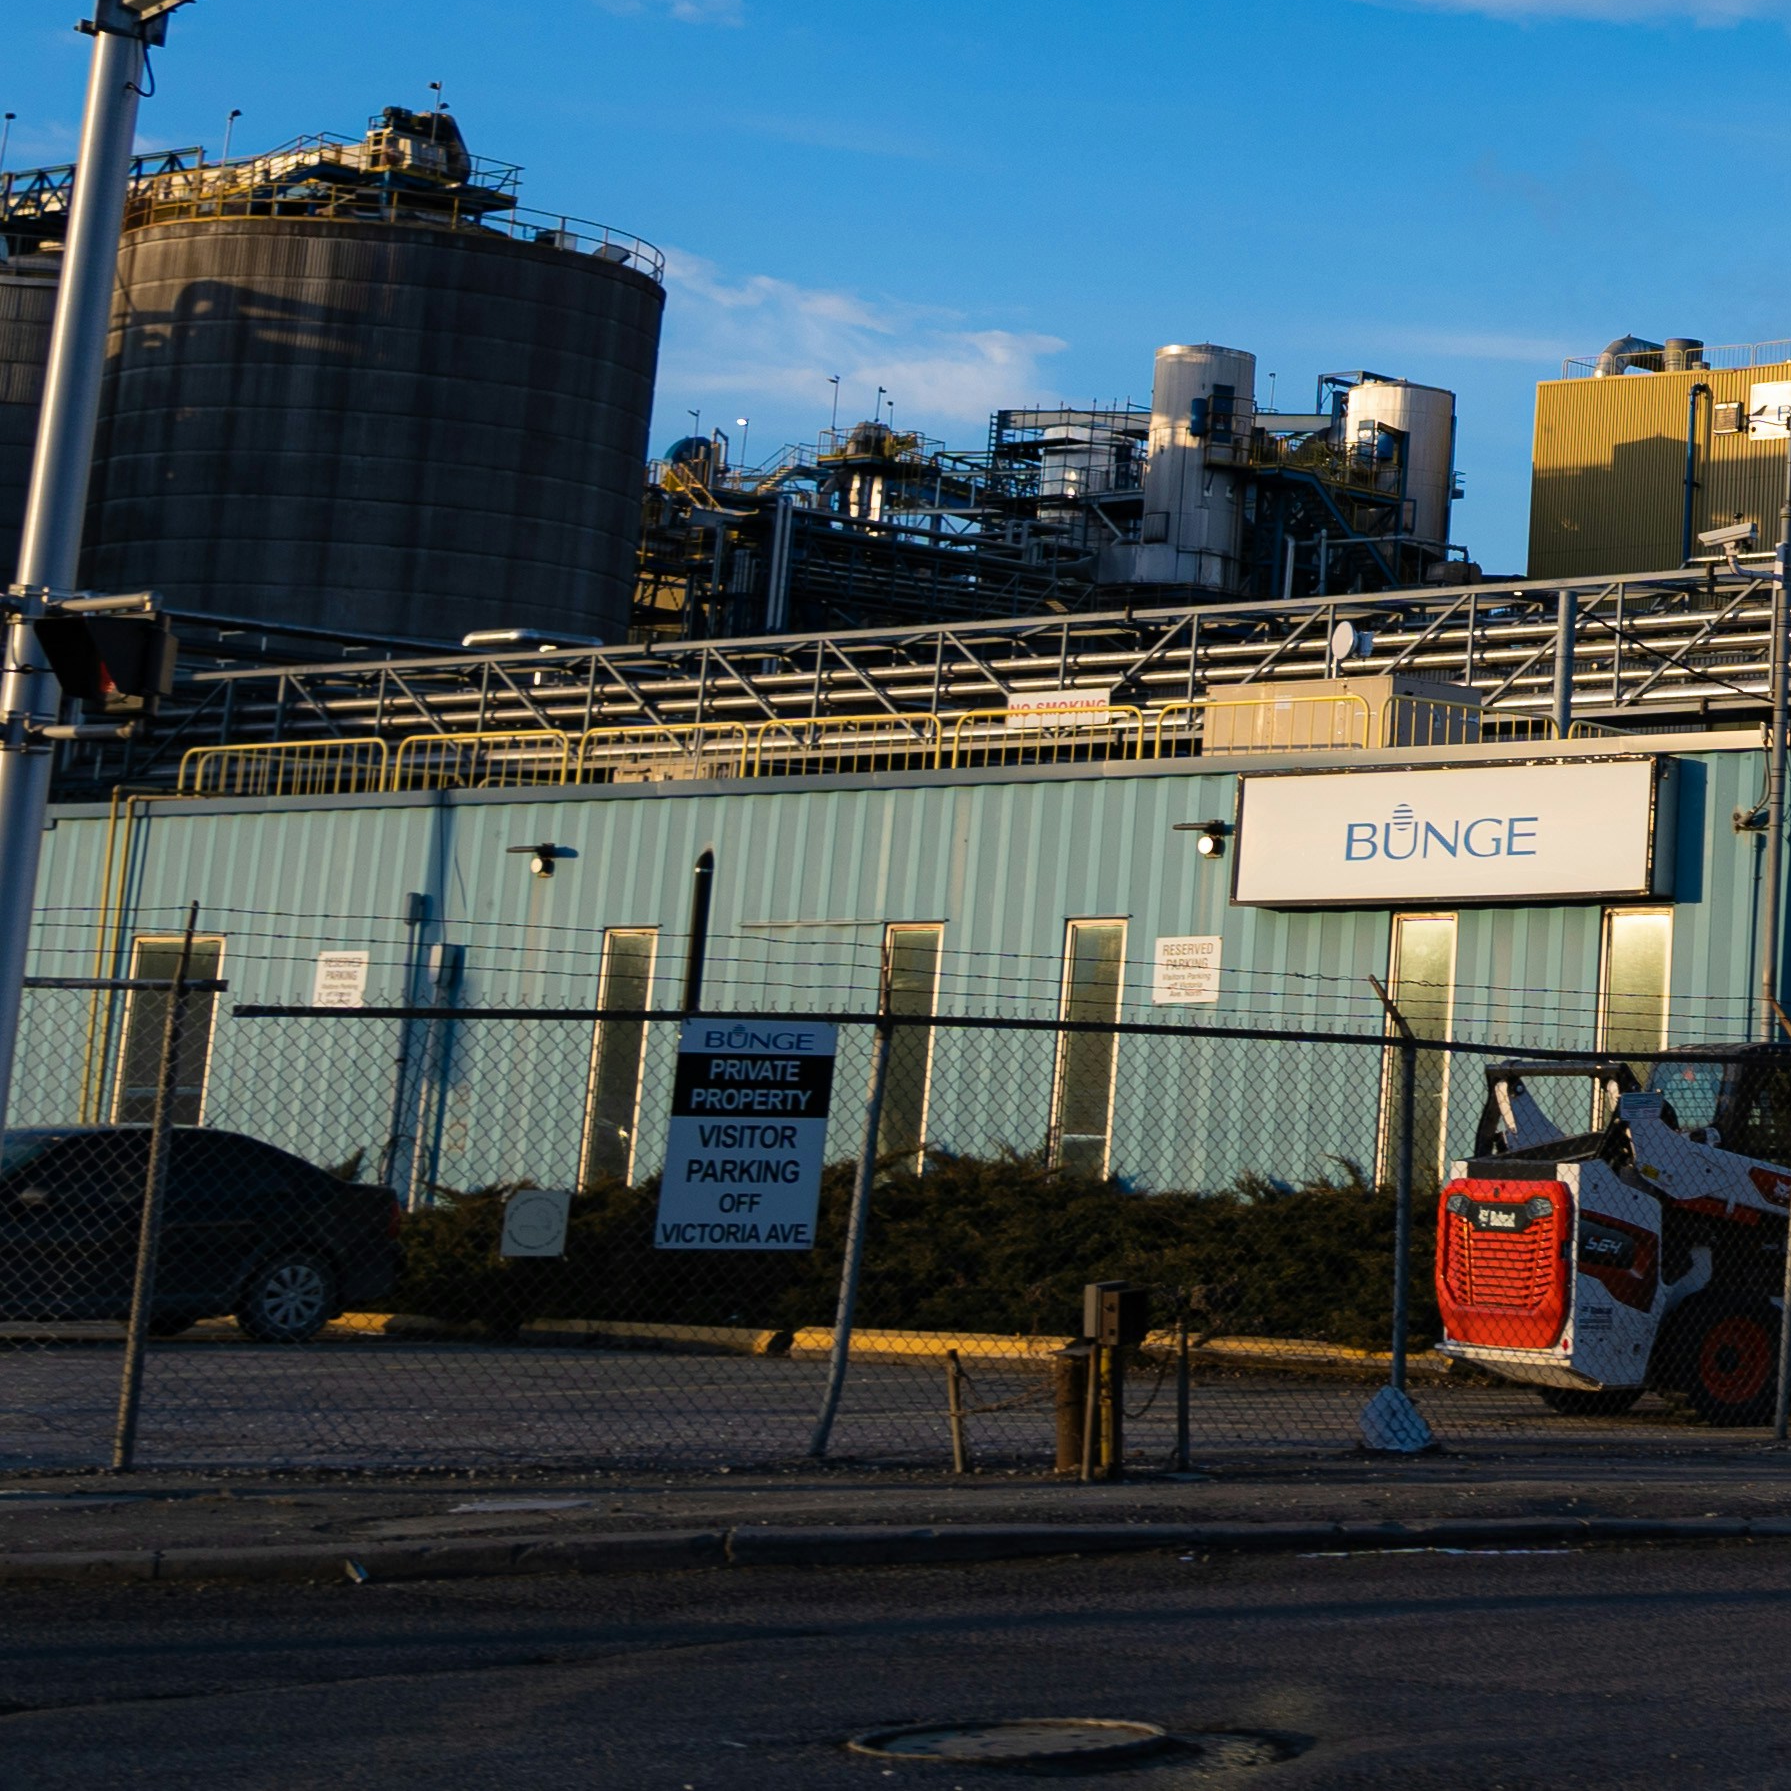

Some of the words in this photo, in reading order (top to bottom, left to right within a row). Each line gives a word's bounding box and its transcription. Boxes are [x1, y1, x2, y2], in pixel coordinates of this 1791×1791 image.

[1010, 703, 1031, 717] NO
[1036, 699, 1107, 717] SMOKING
[1345, 817, 1539, 861] BUNGE
[1162, 942, 1214, 956] RESERVED
[1166, 958, 1208, 971] PARKING
[705, 1030, 815, 1051] BUNGE
[709, 1059, 801, 1081] PRIVATE
[691, 1089, 812, 1110] PROPERTY
[698, 1125, 798, 1149] VISITOR
[686, 1160, 800, 1184] PARKING
[718, 1193, 762, 1213] OFF
[661, 1223, 760, 1244] VICTORIA
